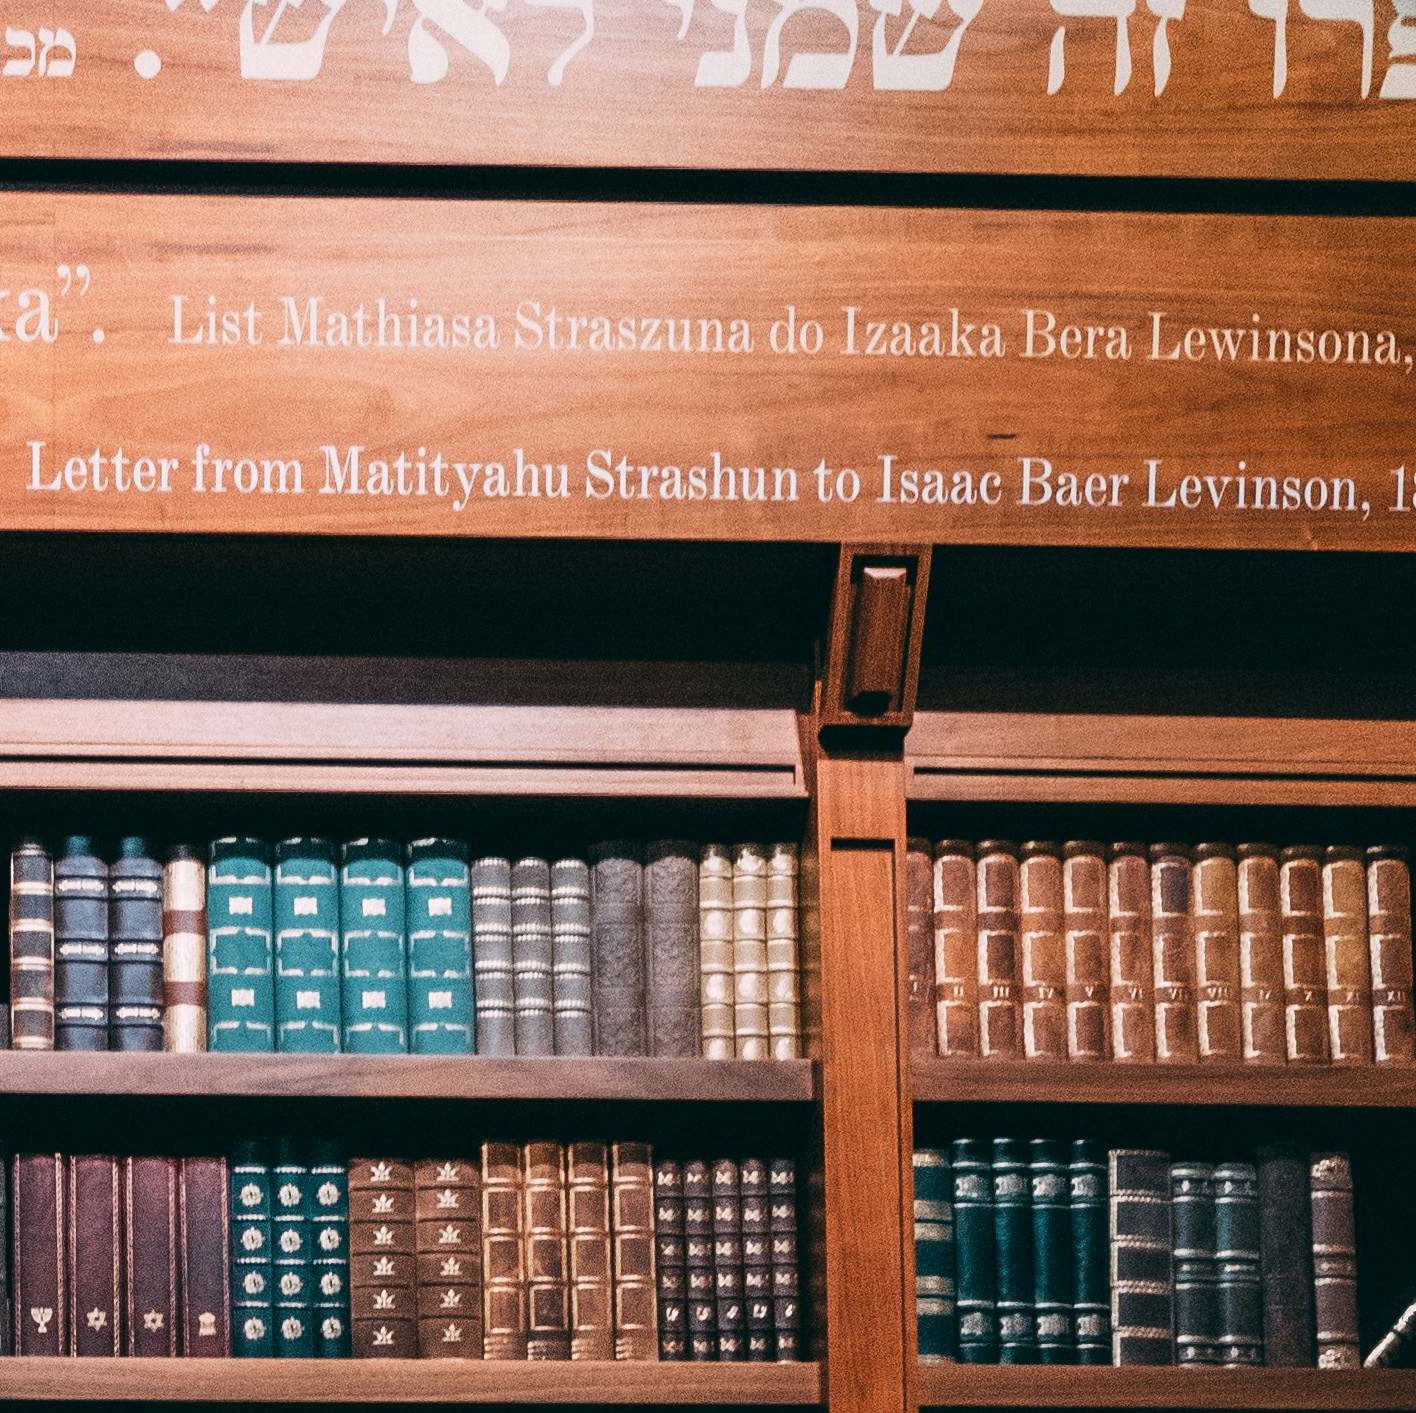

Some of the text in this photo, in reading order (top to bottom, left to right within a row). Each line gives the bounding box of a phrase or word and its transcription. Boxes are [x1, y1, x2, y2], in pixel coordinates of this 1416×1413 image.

[168, 294, 1414, 374] List Mathiasa Straszuna do Izaaka Bera Lewinsona,
[25, 440, 1416, 521] Letter from Matityahu Strashun to Isaac Baer Levinson, 1
